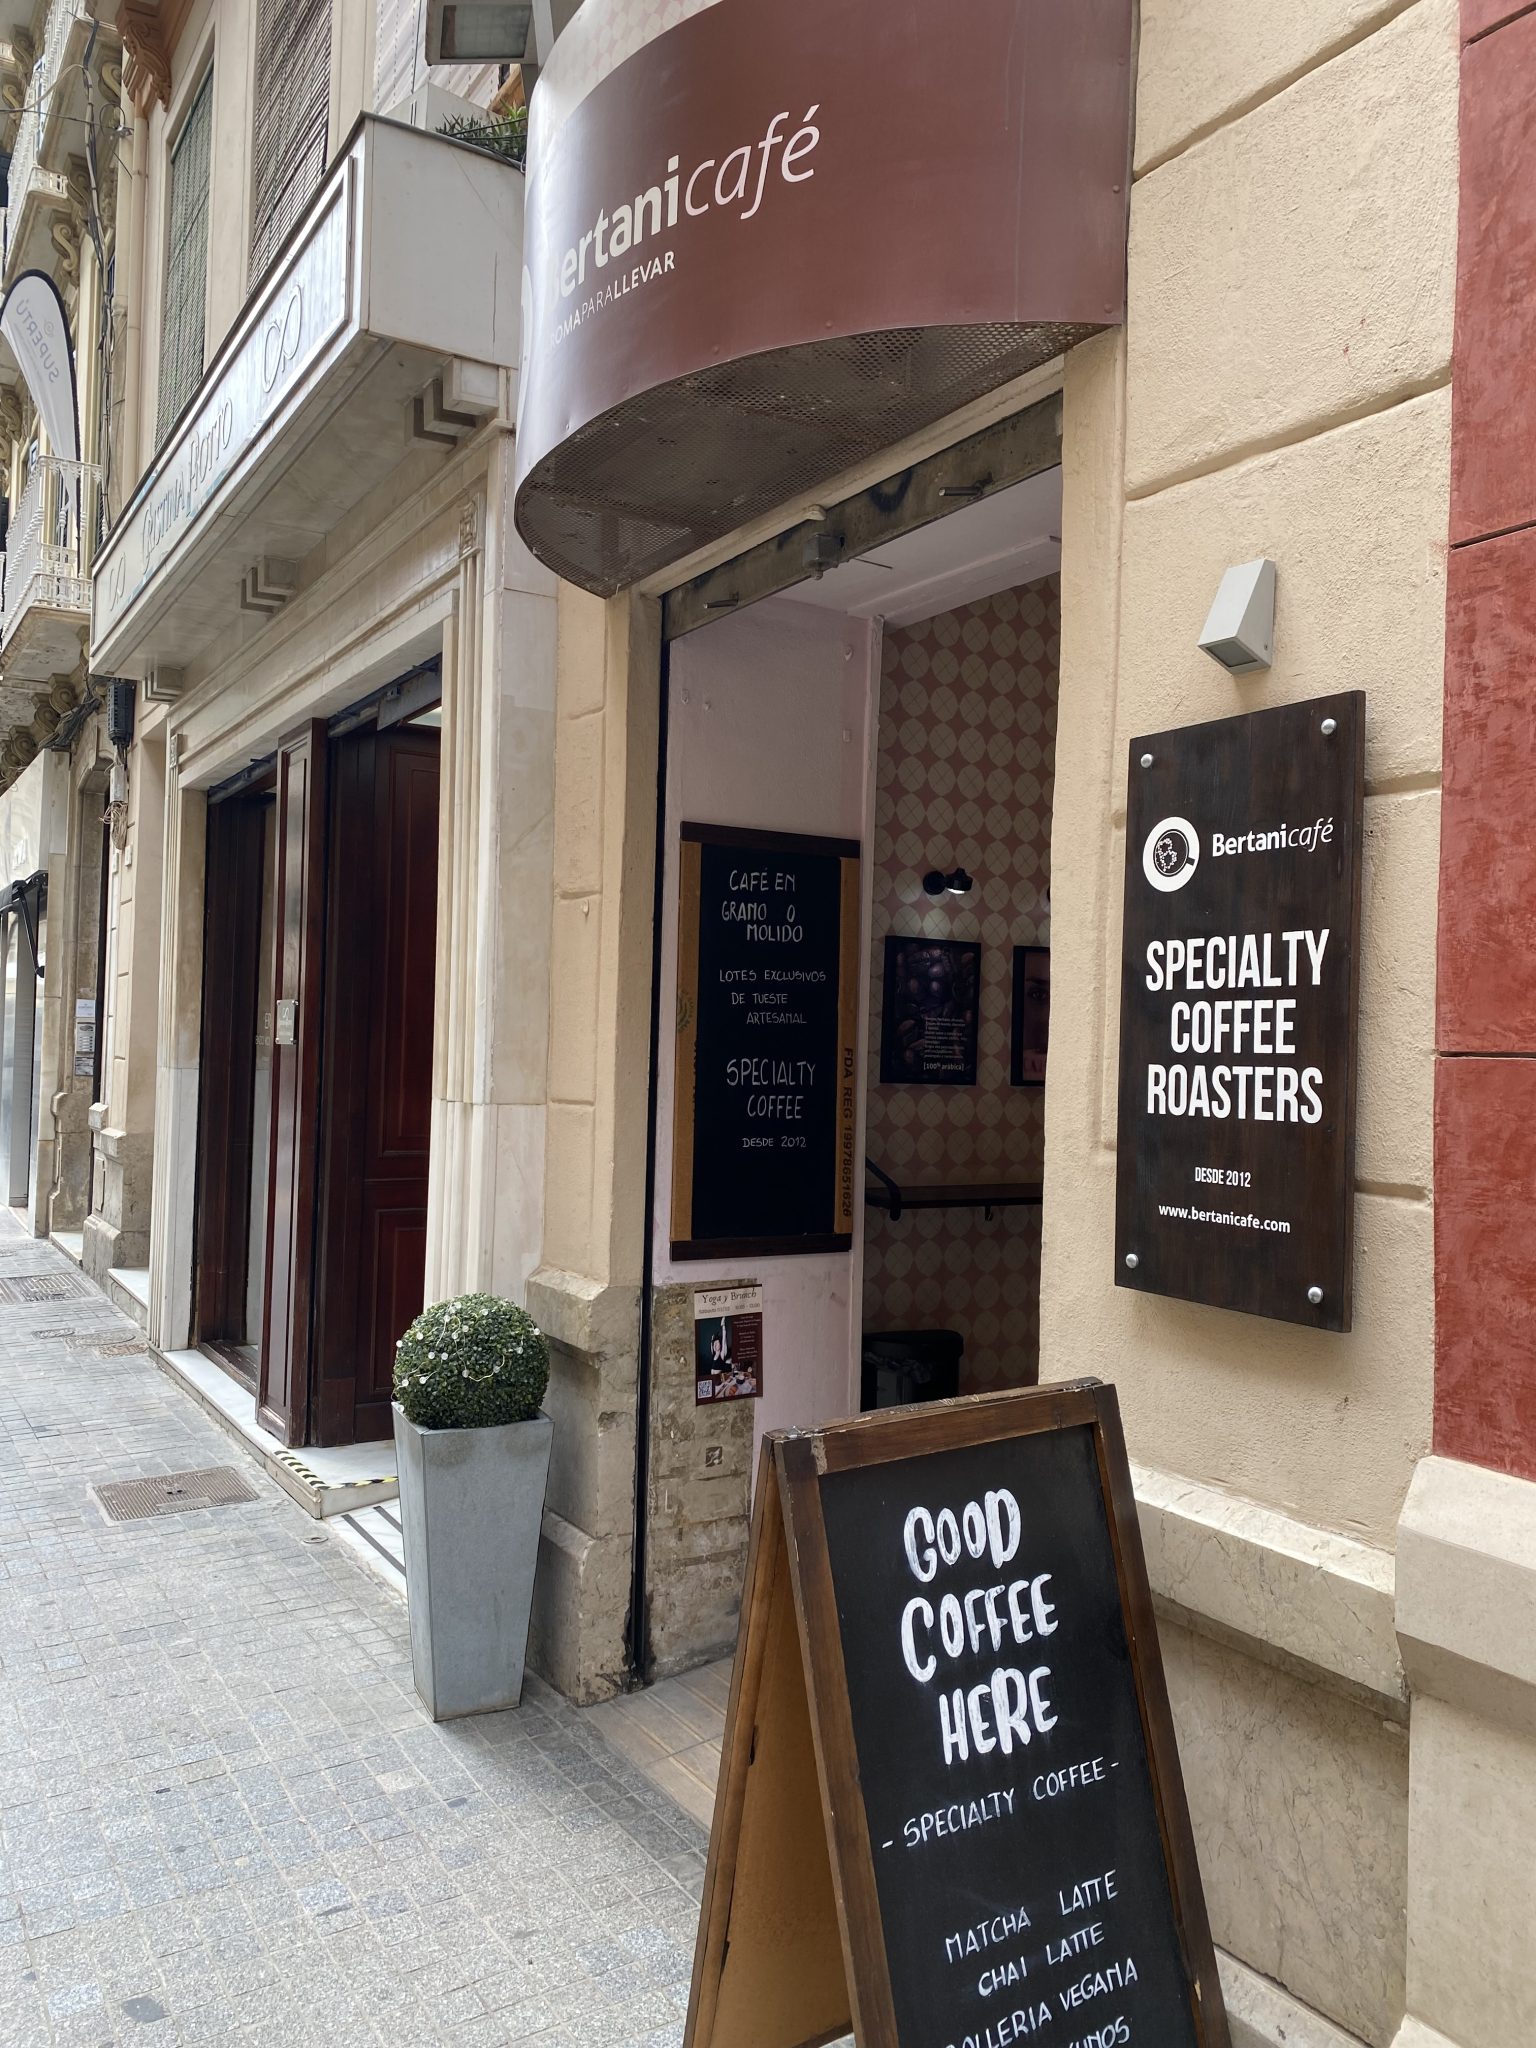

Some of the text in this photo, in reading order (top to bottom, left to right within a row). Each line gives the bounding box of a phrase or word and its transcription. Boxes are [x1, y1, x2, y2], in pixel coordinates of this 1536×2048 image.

[1212, 817, 1334, 857] Bertanicafé
[729, 867, 796, 891] CAFÉ EN
[721, 900, 796, 922] GRANO O
[746, 923, 803, 942] MOLIDO
[719, 969, 827, 982] LOTES EXCLUSIVOS
[1145, 929, 1330, 991] SPECIALTY
[731, 992, 789, 1005] DE TUESTE
[746, 1012, 808, 1025] ARTESANAL
[1170, 999, 1297, 1054] COFFEE
[726, 1057, 816, 1086] SPECIALTY
[843, 1047, 854, 1079] FDA
[747, 1094, 804, 1119] COFFEE
[842, 1087, 853, 1119] REG
[1147, 1064, 1323, 1124] ROASTERS
[742, 1135, 807, 1148] DESDE 2012
[1194, 1166, 1251, 1188] DESDE 2012
[1158, 1205, 1291, 1234] www.bertanicafe.com
[904, 1488, 1022, 1583] GOOD
[901, 1574, 1059, 1683] COFFEE
[938, 1666, 1059, 1765] HERE
[903, 1787, 1015, 1847] SPECIALTY
[945, 1869, 1119, 1964] MATCHA LATTE
[978, 1922, 1105, 1997] CHAI LATTE
[944, 1957, 1138, 2048] LLERIA VEGANA
